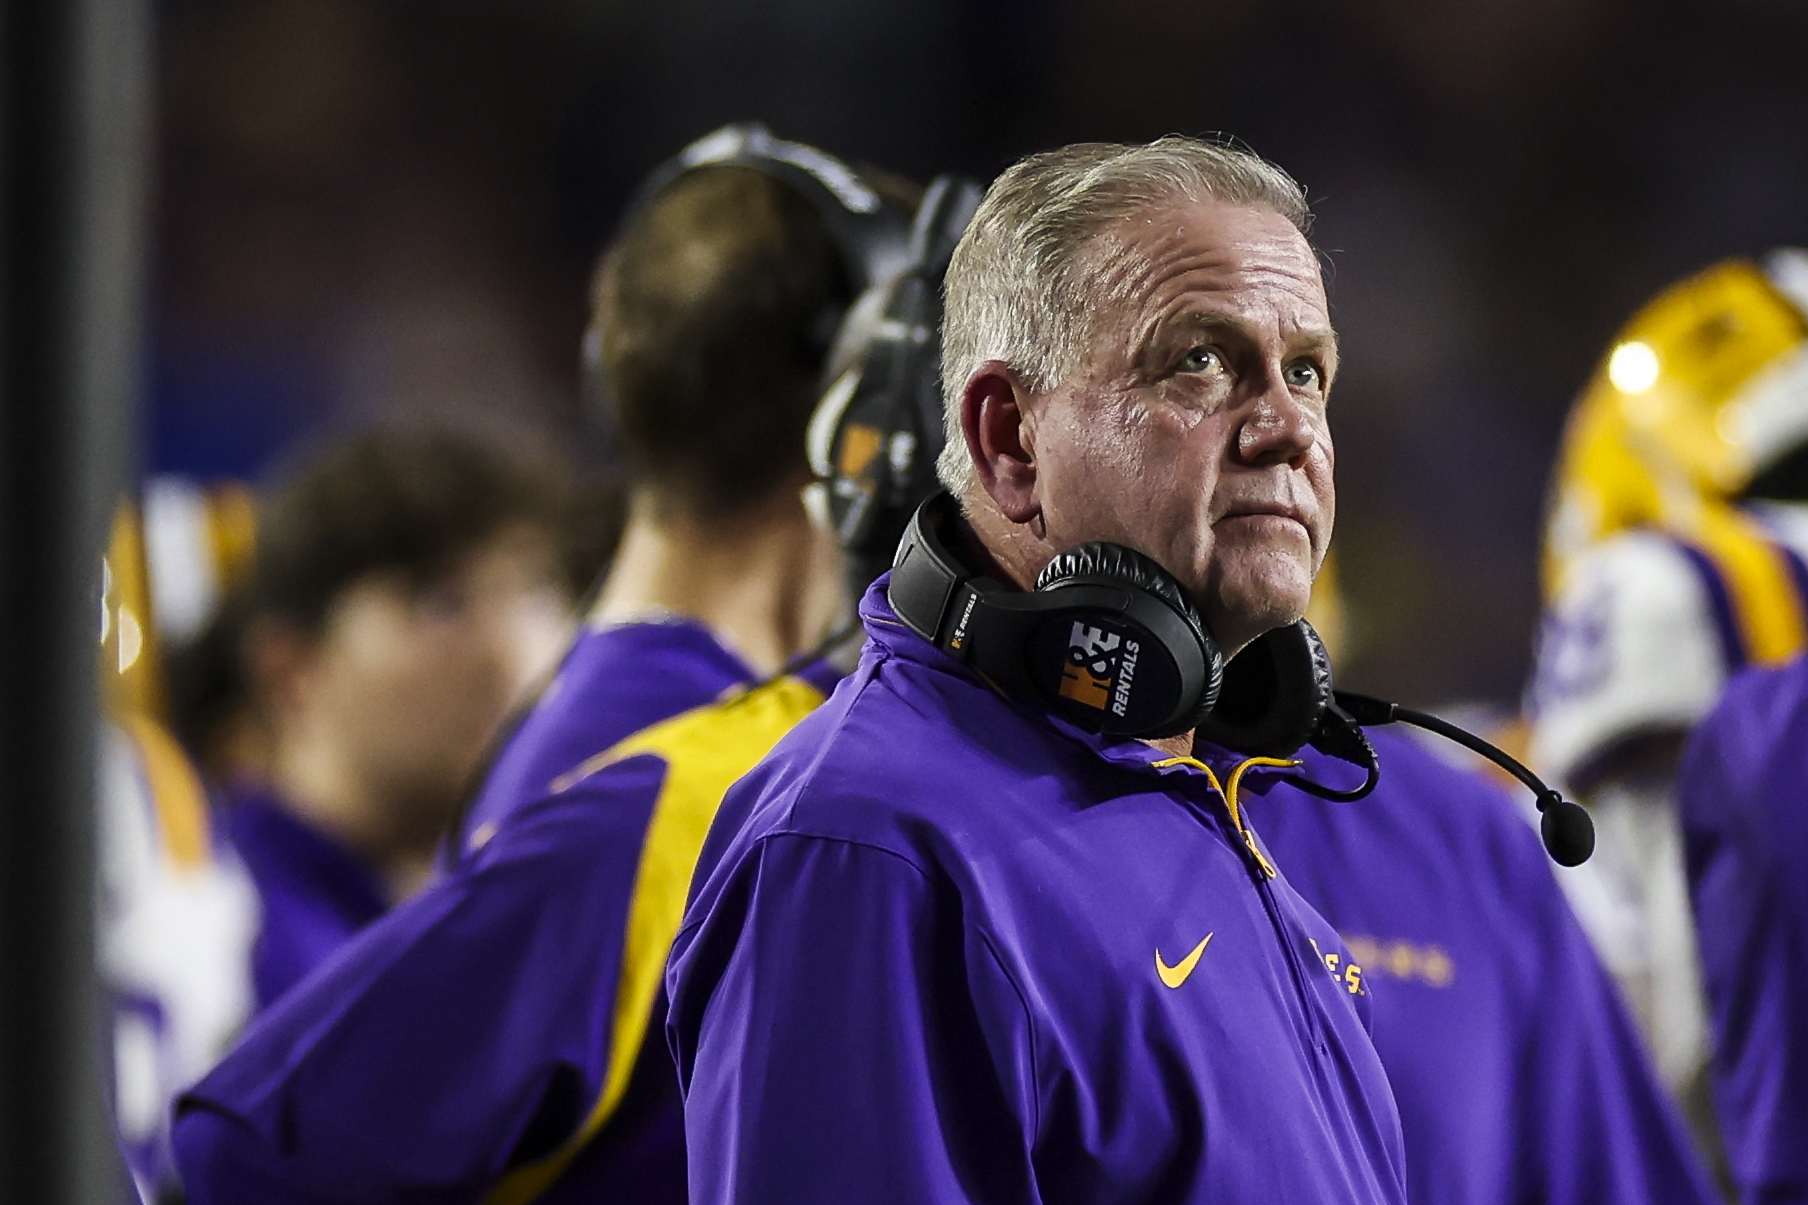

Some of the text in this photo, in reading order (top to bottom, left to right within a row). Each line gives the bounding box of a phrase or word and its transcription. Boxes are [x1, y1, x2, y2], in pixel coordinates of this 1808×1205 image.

[960, 593, 977, 630] RENTALS
[1059, 620, 1121, 711] H&E
[1112, 640, 1140, 717] RENTALS
